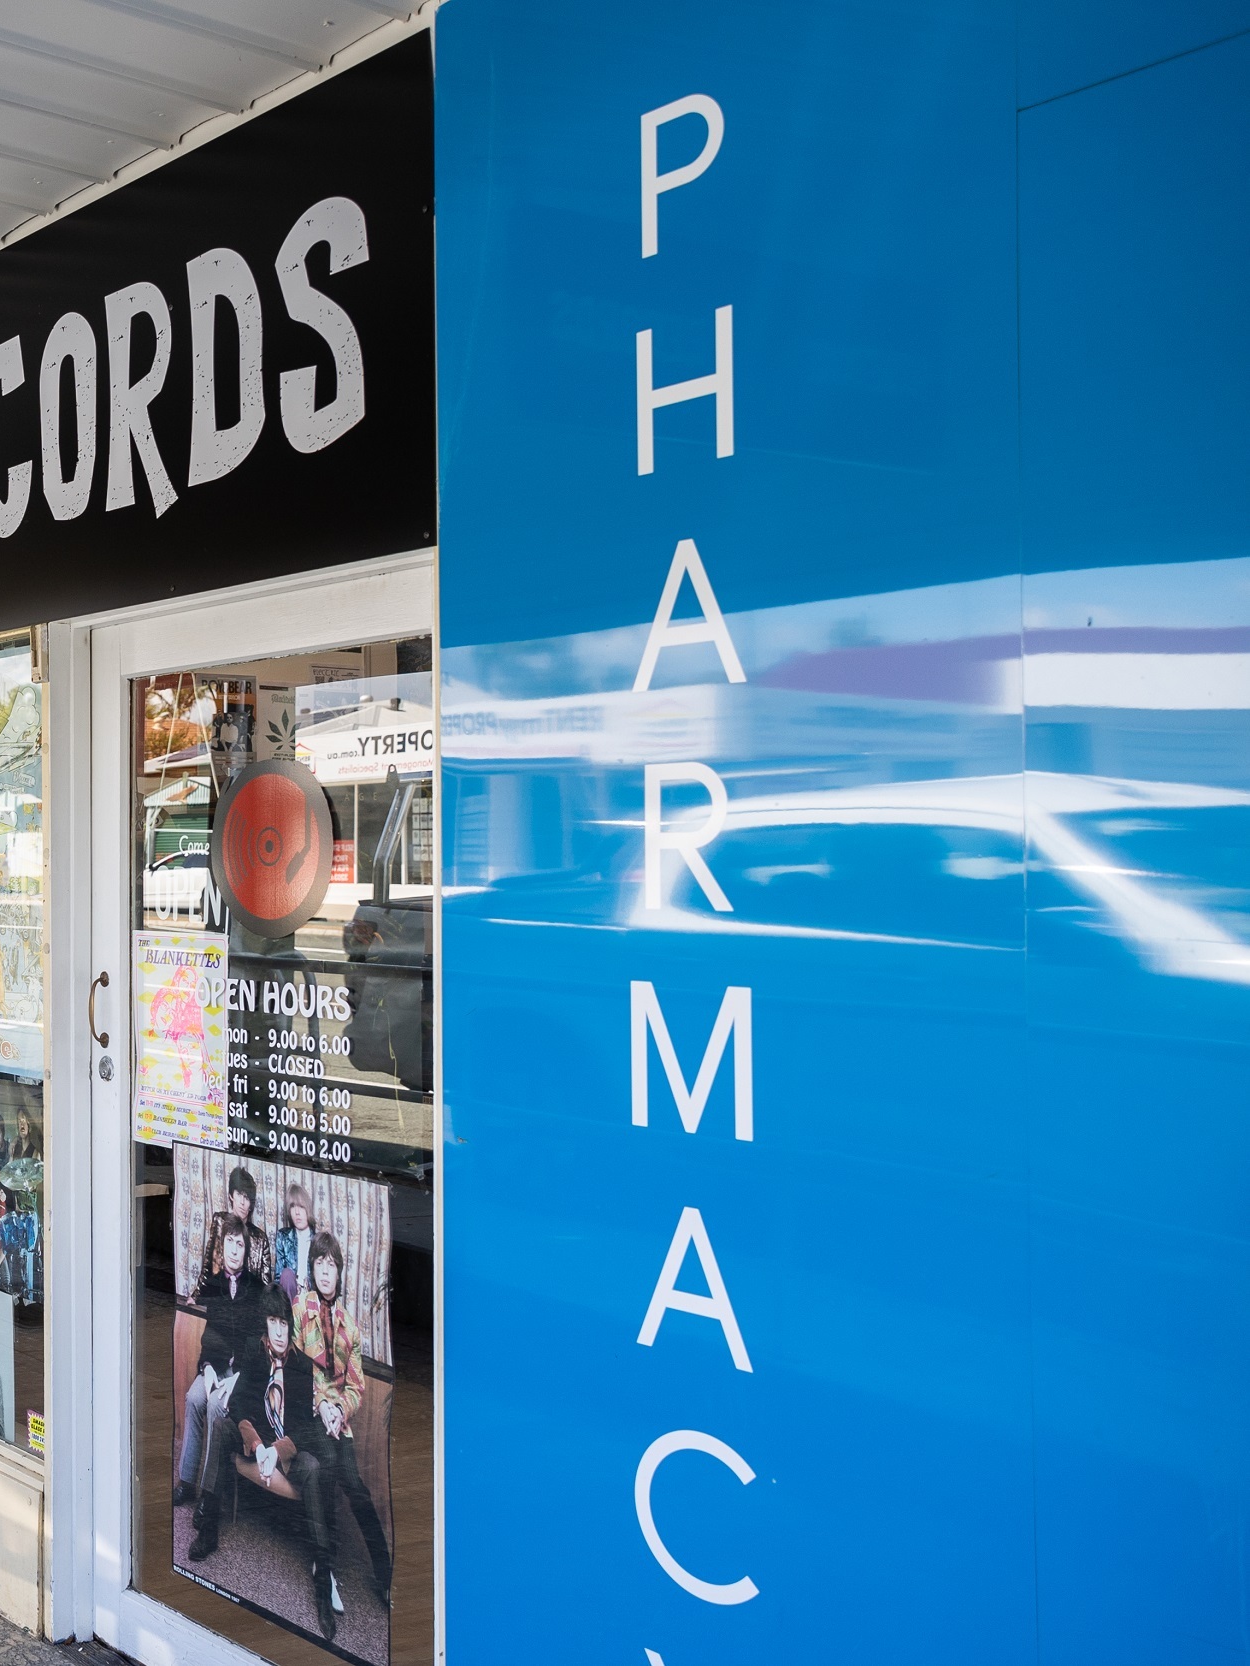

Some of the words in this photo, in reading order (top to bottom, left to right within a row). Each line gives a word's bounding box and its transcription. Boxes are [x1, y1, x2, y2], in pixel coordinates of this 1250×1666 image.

[228, 680, 252, 695] BEAR
[178, 835, 211, 857] Come
[630, 93, 760, 1666] PHARMAC
[154, 864, 223, 927] OPEN
[137, 939, 151, 947] THE
[144, 948, 222, 970] BLANKETTES
[195, 976, 256, 1013] OPEN
[263, 981, 351, 1022] HOURS
[268, 1028, 298, 1050] 9.00
[301, 1034, 315, 1053] to
[319, 1034, 351, 1057] 6.00
[225, 1052, 248, 1070] ues
[268, 1053, 325, 1079] CLOSED
[232, 1074, 248, 1095] fri
[268, 1080, 298, 1102] 9.00
[301, 1087, 315, 1105] to
[319, 1087, 351, 1110] 6.00
[228, 1102, 248, 1120] sat
[268, 1105, 298, 1127] 9.00
[301, 1111, 316, 1130] to
[319, 1113, 351, 1136] 5.00
[226, 1126, 248, 1144] sun
[268, 1130, 299, 1153] 9.00
[301, 1137, 316, 1156] to
[319, 1139, 351, 1163] 2.00
[31, 1424, 43, 1433] GLASS
[173, 1564, 195, 1581] ROLLING
[195, 1576, 216, 1591] STONES
